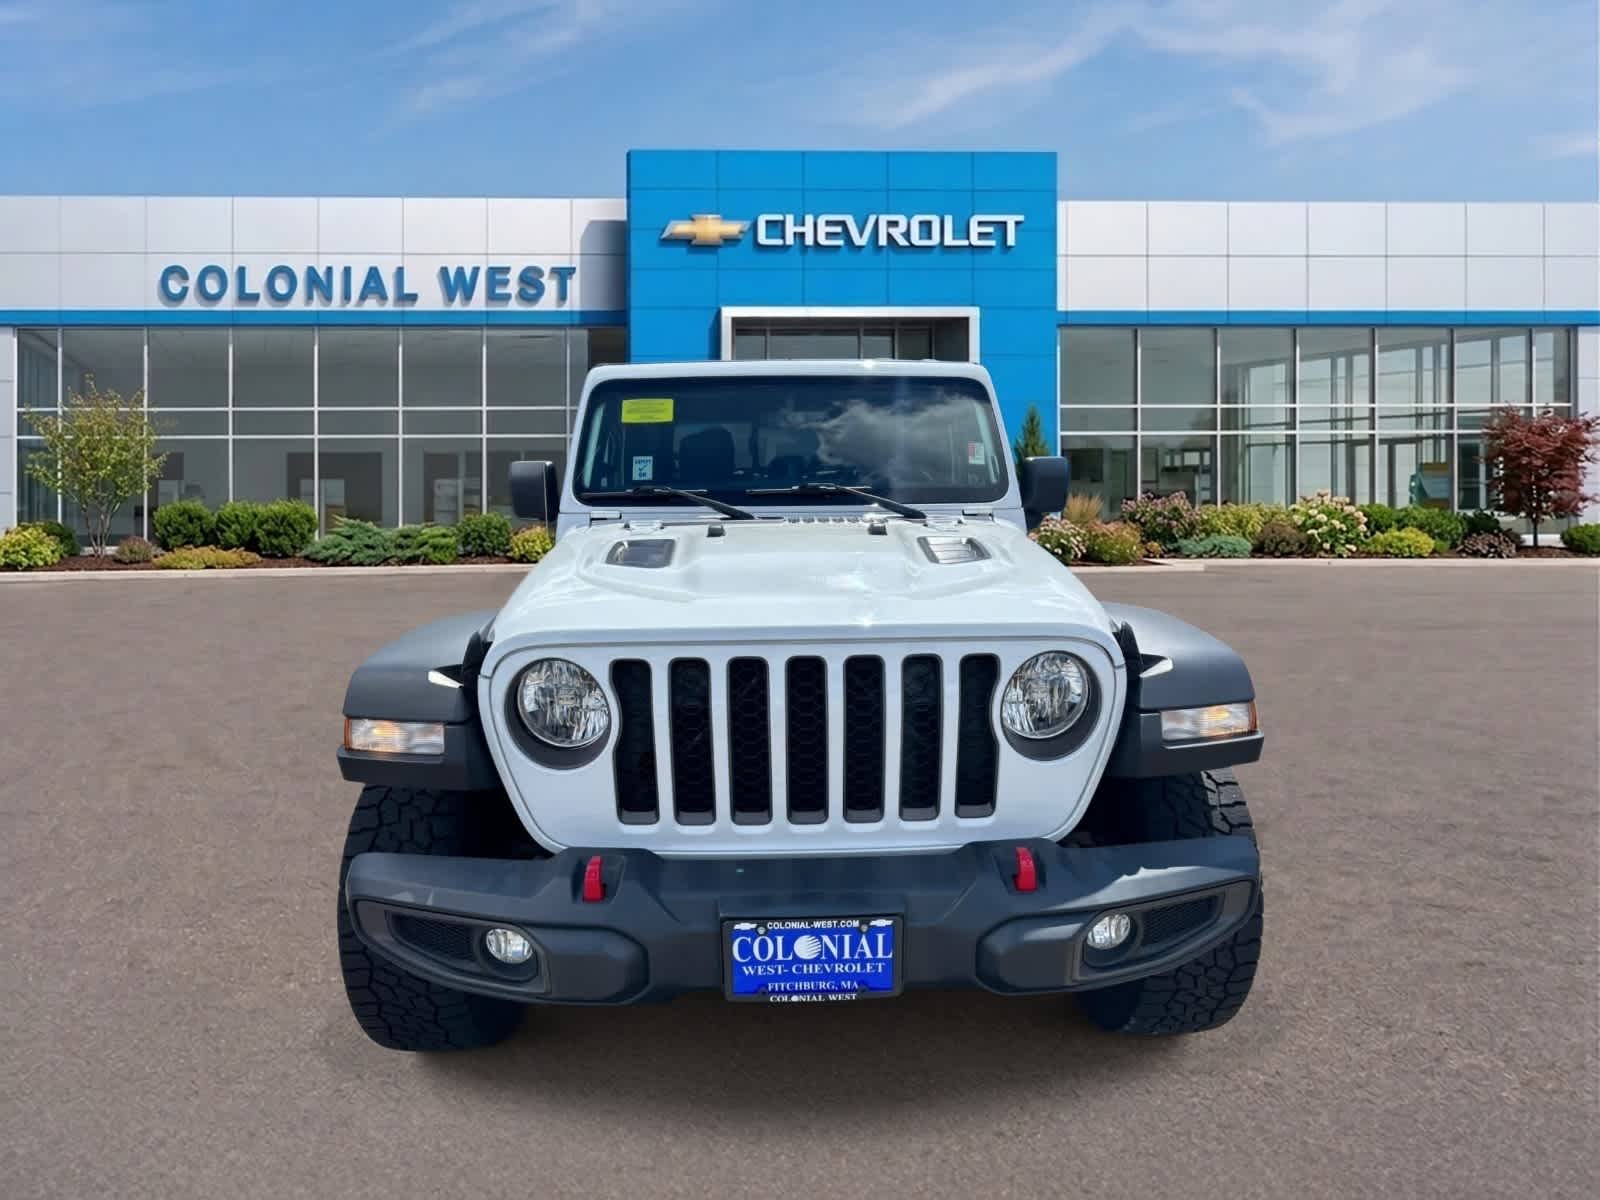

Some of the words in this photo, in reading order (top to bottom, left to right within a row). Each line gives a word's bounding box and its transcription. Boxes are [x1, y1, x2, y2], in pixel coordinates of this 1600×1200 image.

[757, 213, 1025, 247] CHEVROLET
[160, 264, 419, 304] COLONIAL
[438, 265, 577, 304] WEST
[766, 919, 860, 931] COLONIAL-WEST.COM
[732, 933, 894, 963] COLONIAL
[791, 962, 886, 975] CHEVROLET
[767, 981, 838, 992] FITCHBURG,
[840, 980, 860, 990] MA
[828, 993, 858, 1002] WEST
